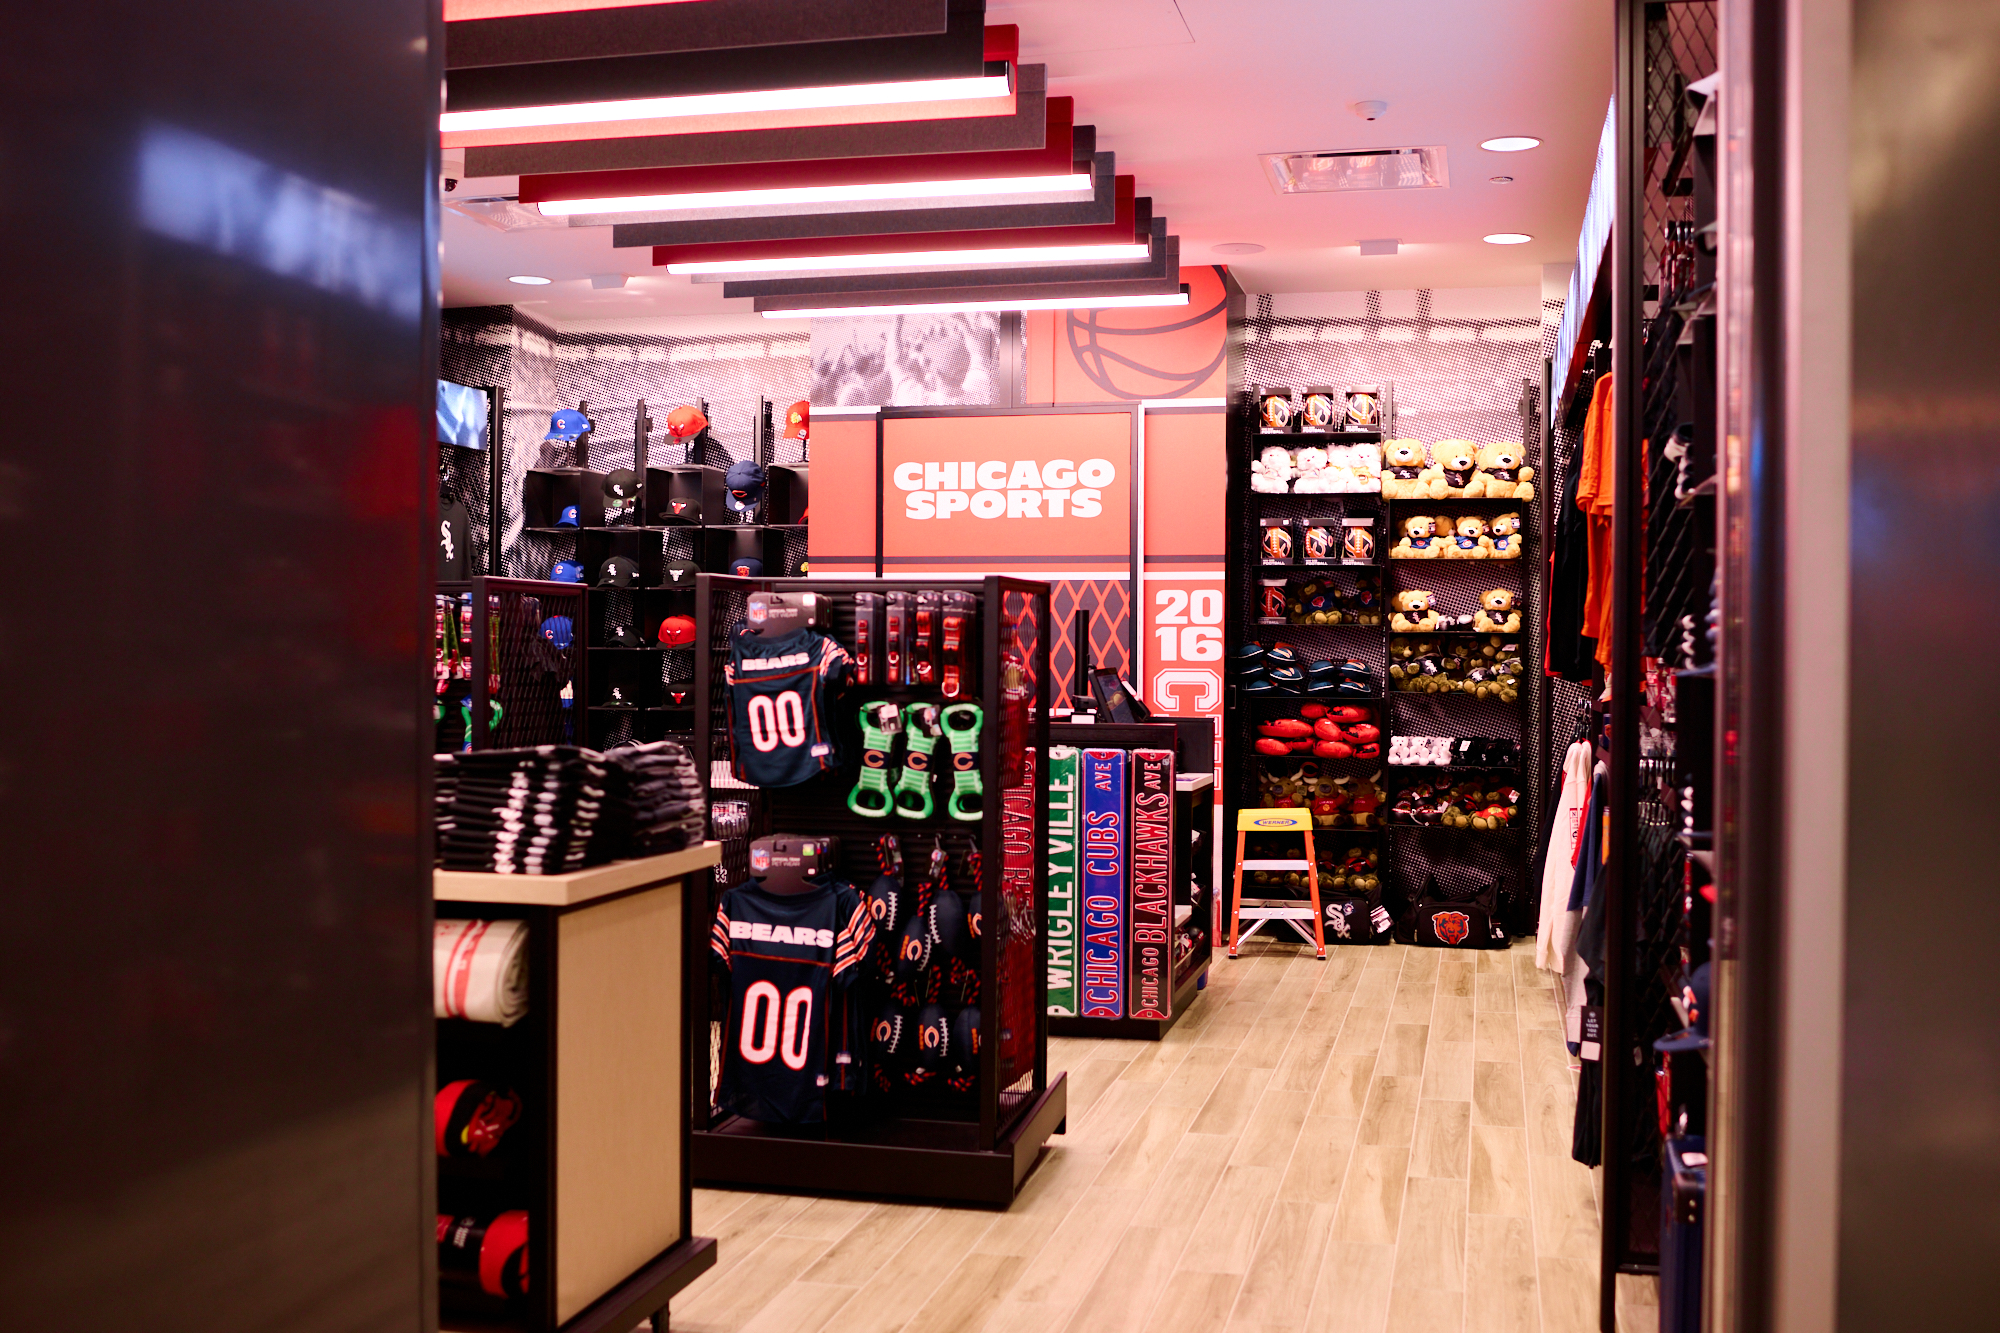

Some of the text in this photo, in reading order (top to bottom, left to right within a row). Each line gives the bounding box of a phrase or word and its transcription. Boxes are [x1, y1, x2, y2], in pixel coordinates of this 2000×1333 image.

[893, 458, 1116, 491] CHICAGO
[905, 488, 1103, 520] SPORTS
[1155, 588, 1223, 625] 20
[741, 652, 810, 672] BEARS
[1155, 626, 1223, 662] 16
[747, 690, 806, 753] 00
[1048, 774, 1074, 990] WRIGLEYVILLE
[1085, 762, 1119, 1004] CHICAGO CUBS AVE
[1135, 762, 1169, 1009] CHICAGO BLACKHAWKS AVE
[729, 921, 834, 949] BEARS
[739, 980, 813, 1071] 00
